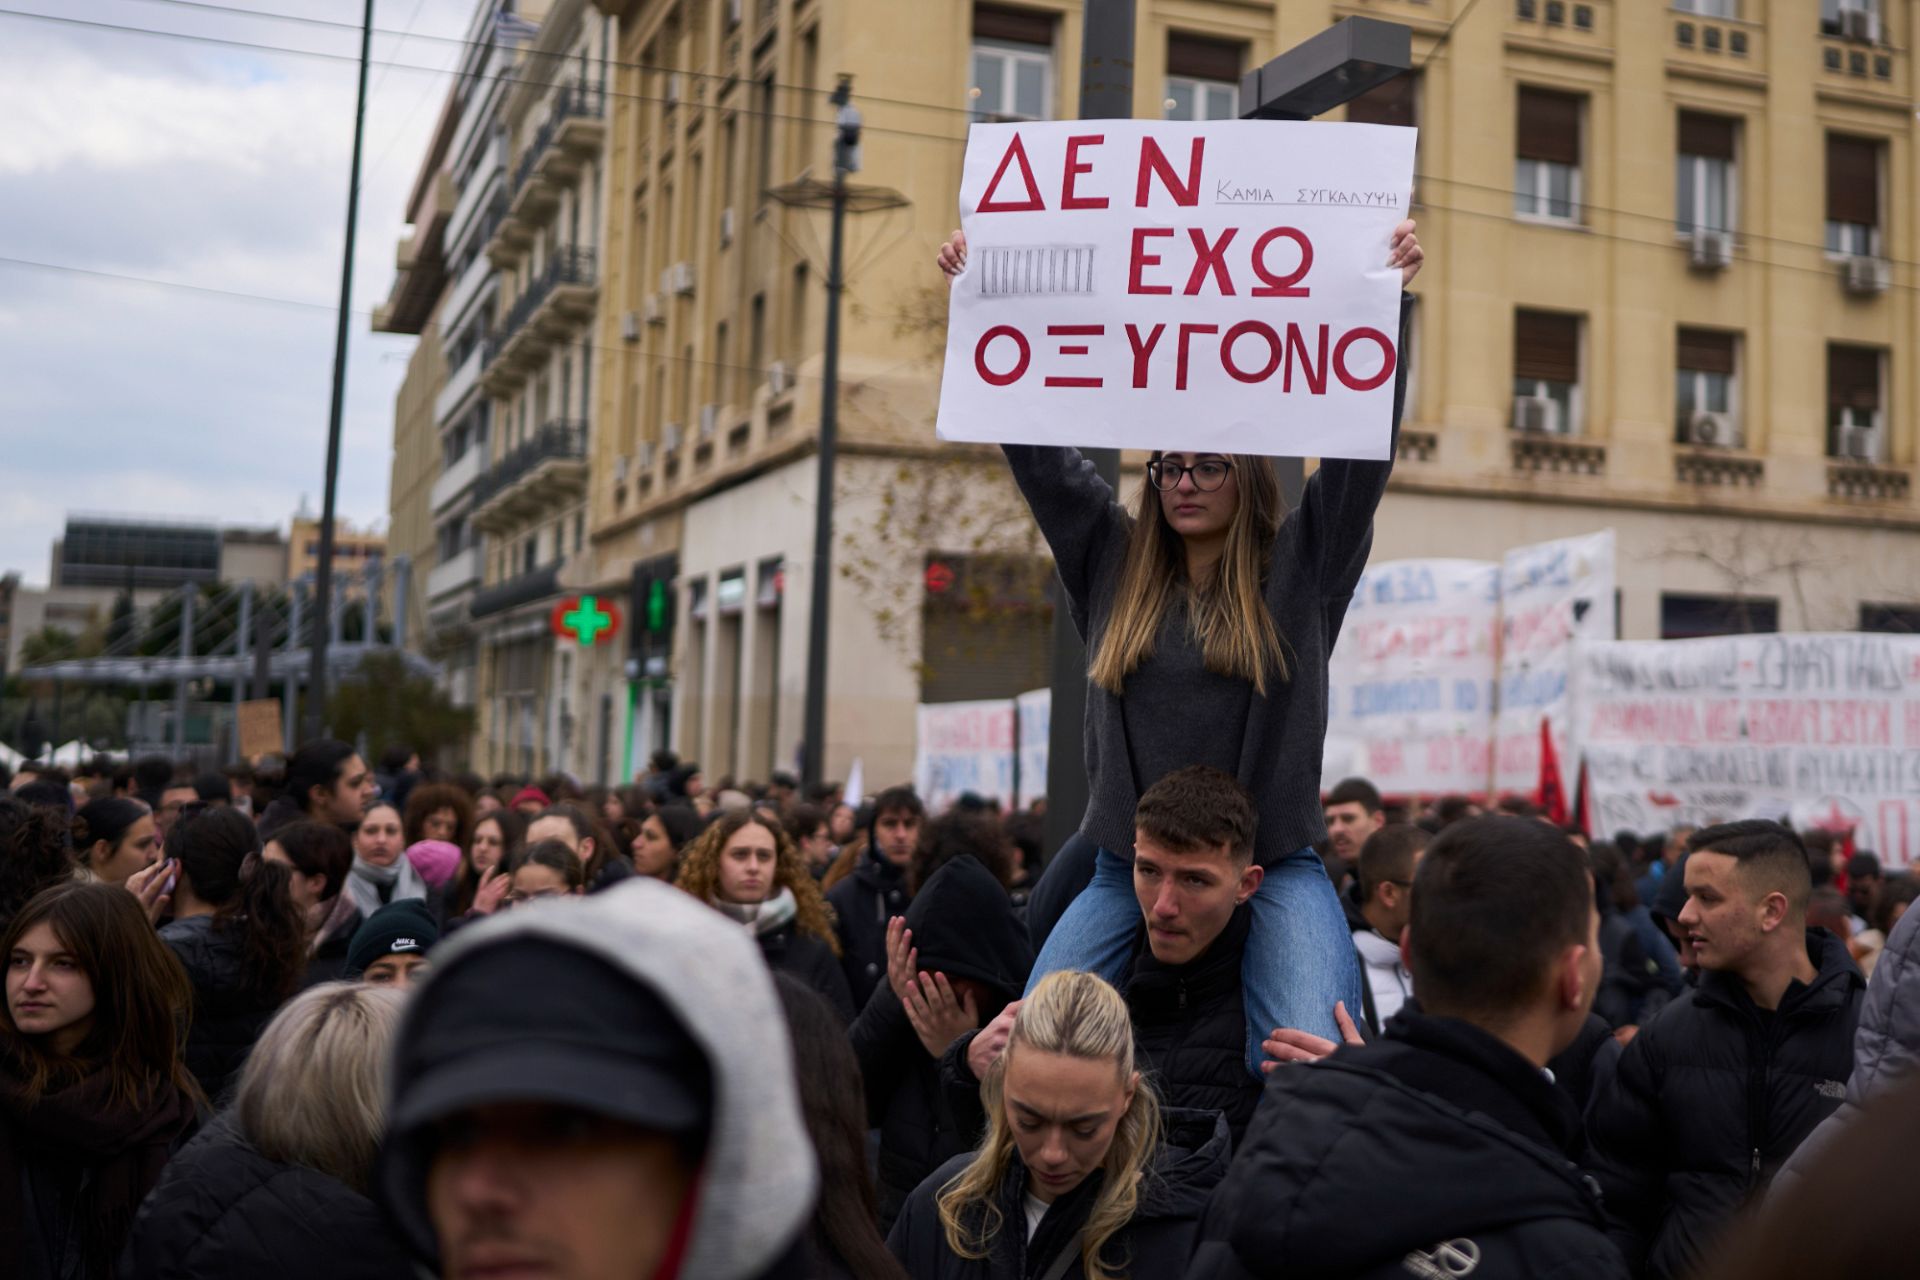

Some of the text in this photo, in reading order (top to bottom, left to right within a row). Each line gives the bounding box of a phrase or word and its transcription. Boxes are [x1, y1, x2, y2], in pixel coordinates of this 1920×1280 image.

[975, 132, 1205, 213] ΔΕΝ
[1216, 179, 1398, 206] ΚΑΜΙΑ ΣΥΓΚΑΛΥΨΗ
[1127, 226, 1314, 298] ΕΧΩ
[974, 319, 1397, 395] ΟΞΥΓΟΝΟ
